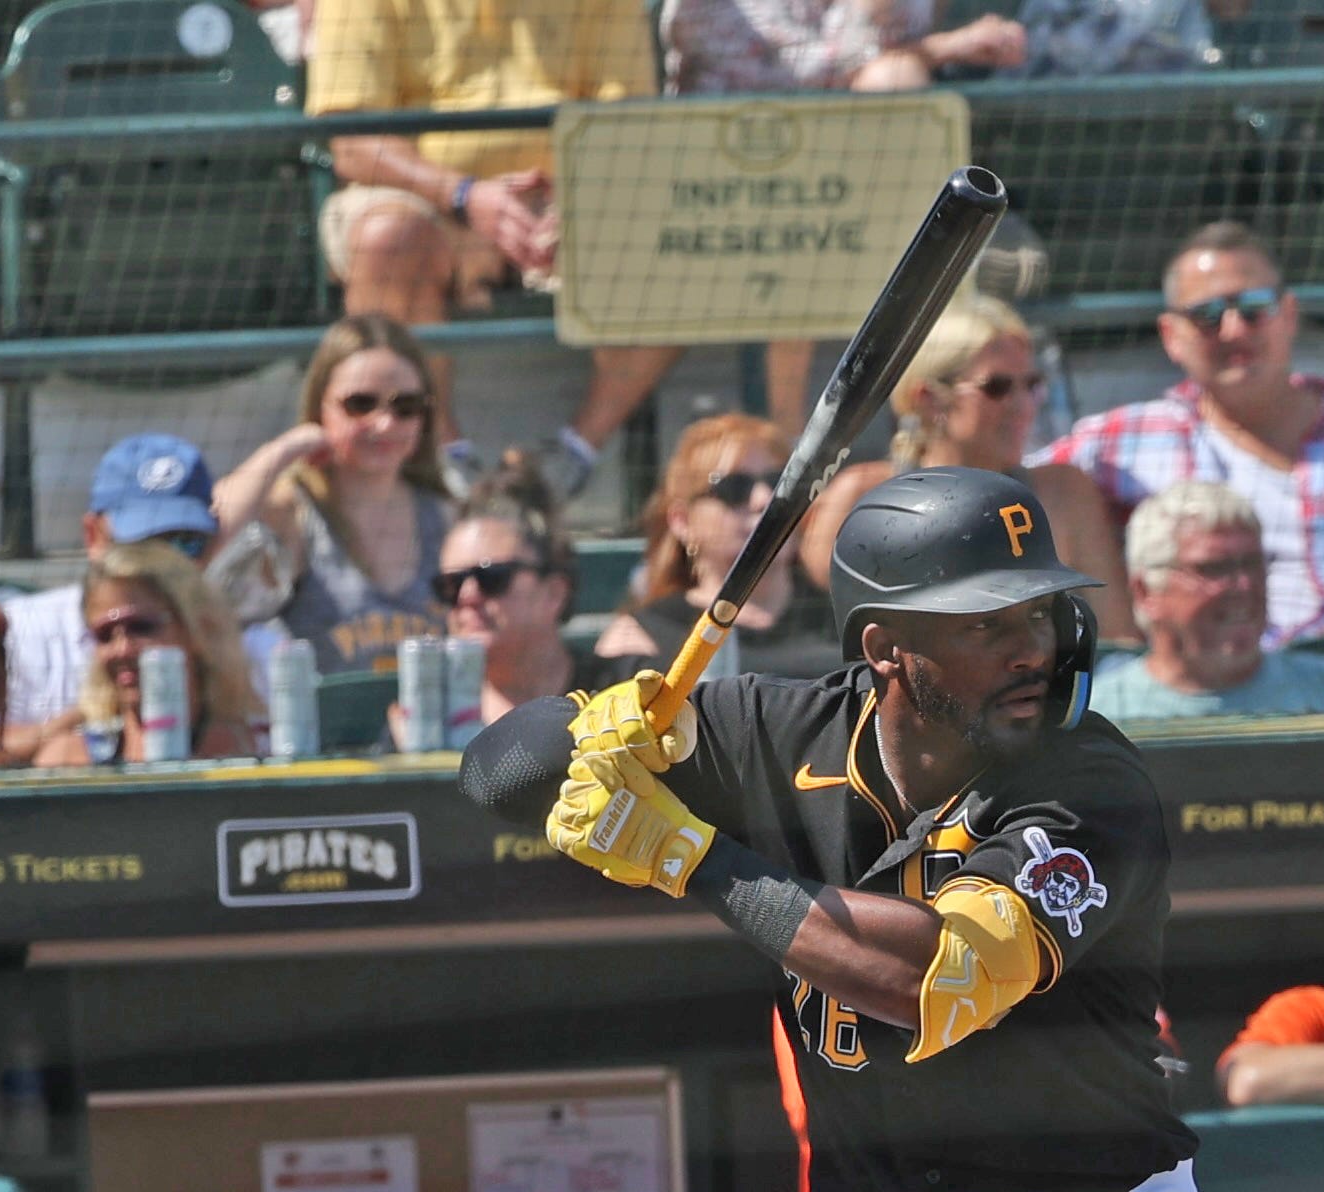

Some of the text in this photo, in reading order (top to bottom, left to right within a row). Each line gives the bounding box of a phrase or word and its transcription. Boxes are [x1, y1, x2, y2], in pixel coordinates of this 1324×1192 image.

[673, 176, 848, 206] INFIELD
[659, 221, 864, 254] RESERVE
[998, 502, 1033, 557] P
[1180, 802, 1248, 832] FOR
[9, 853, 145, 884] TICKETS
[239, 829, 397, 887] PIRATES
